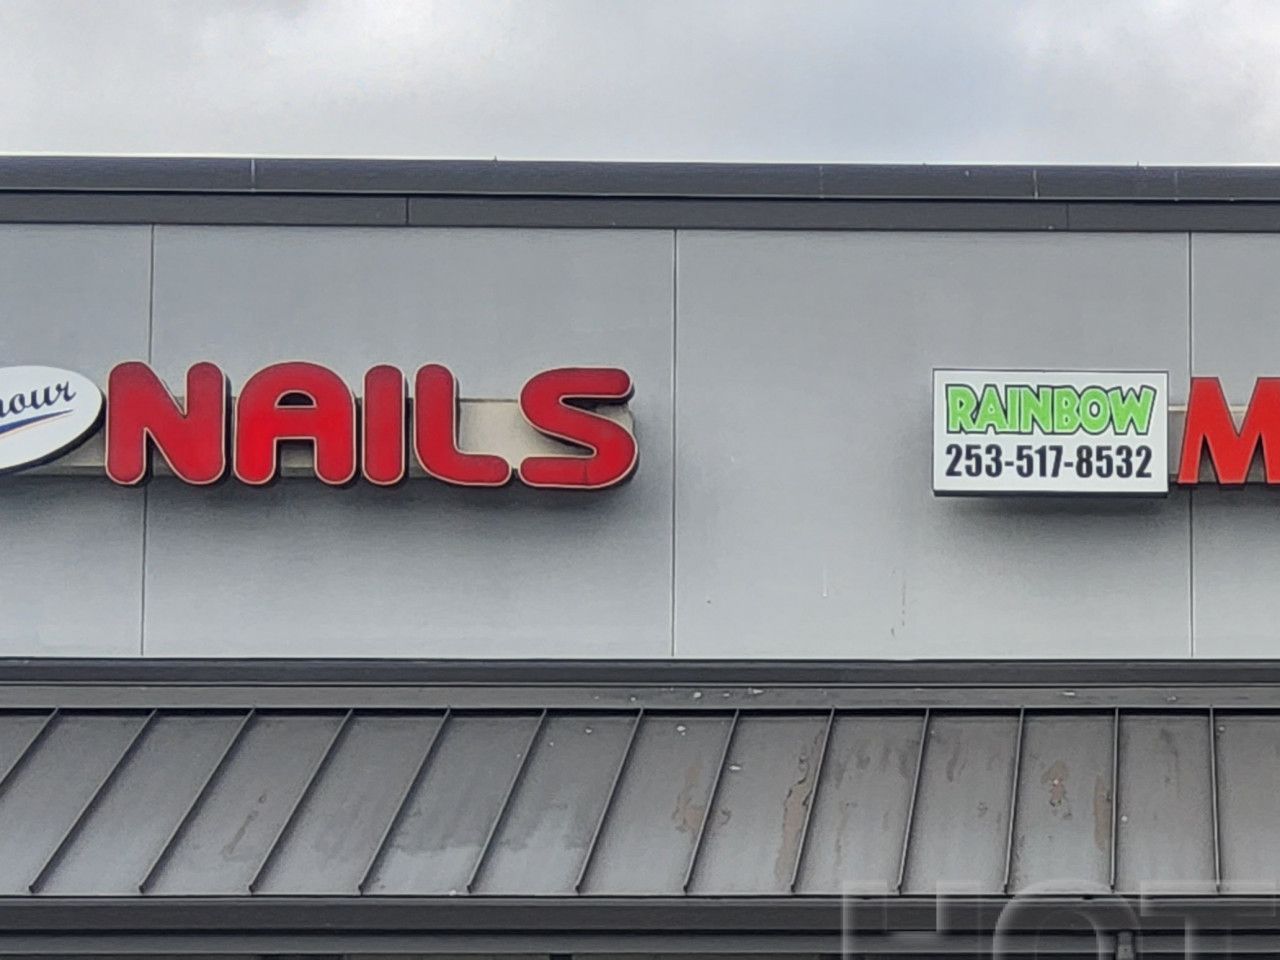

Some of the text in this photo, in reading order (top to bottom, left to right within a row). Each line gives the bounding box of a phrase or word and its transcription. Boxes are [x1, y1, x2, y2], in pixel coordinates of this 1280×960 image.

[0, 381, 77, 418] our
[945, 383, 1157, 435] RAINBOW
[105, 361, 638, 489] NAILS
[945, 443, 1152, 478] 253-517-8532
